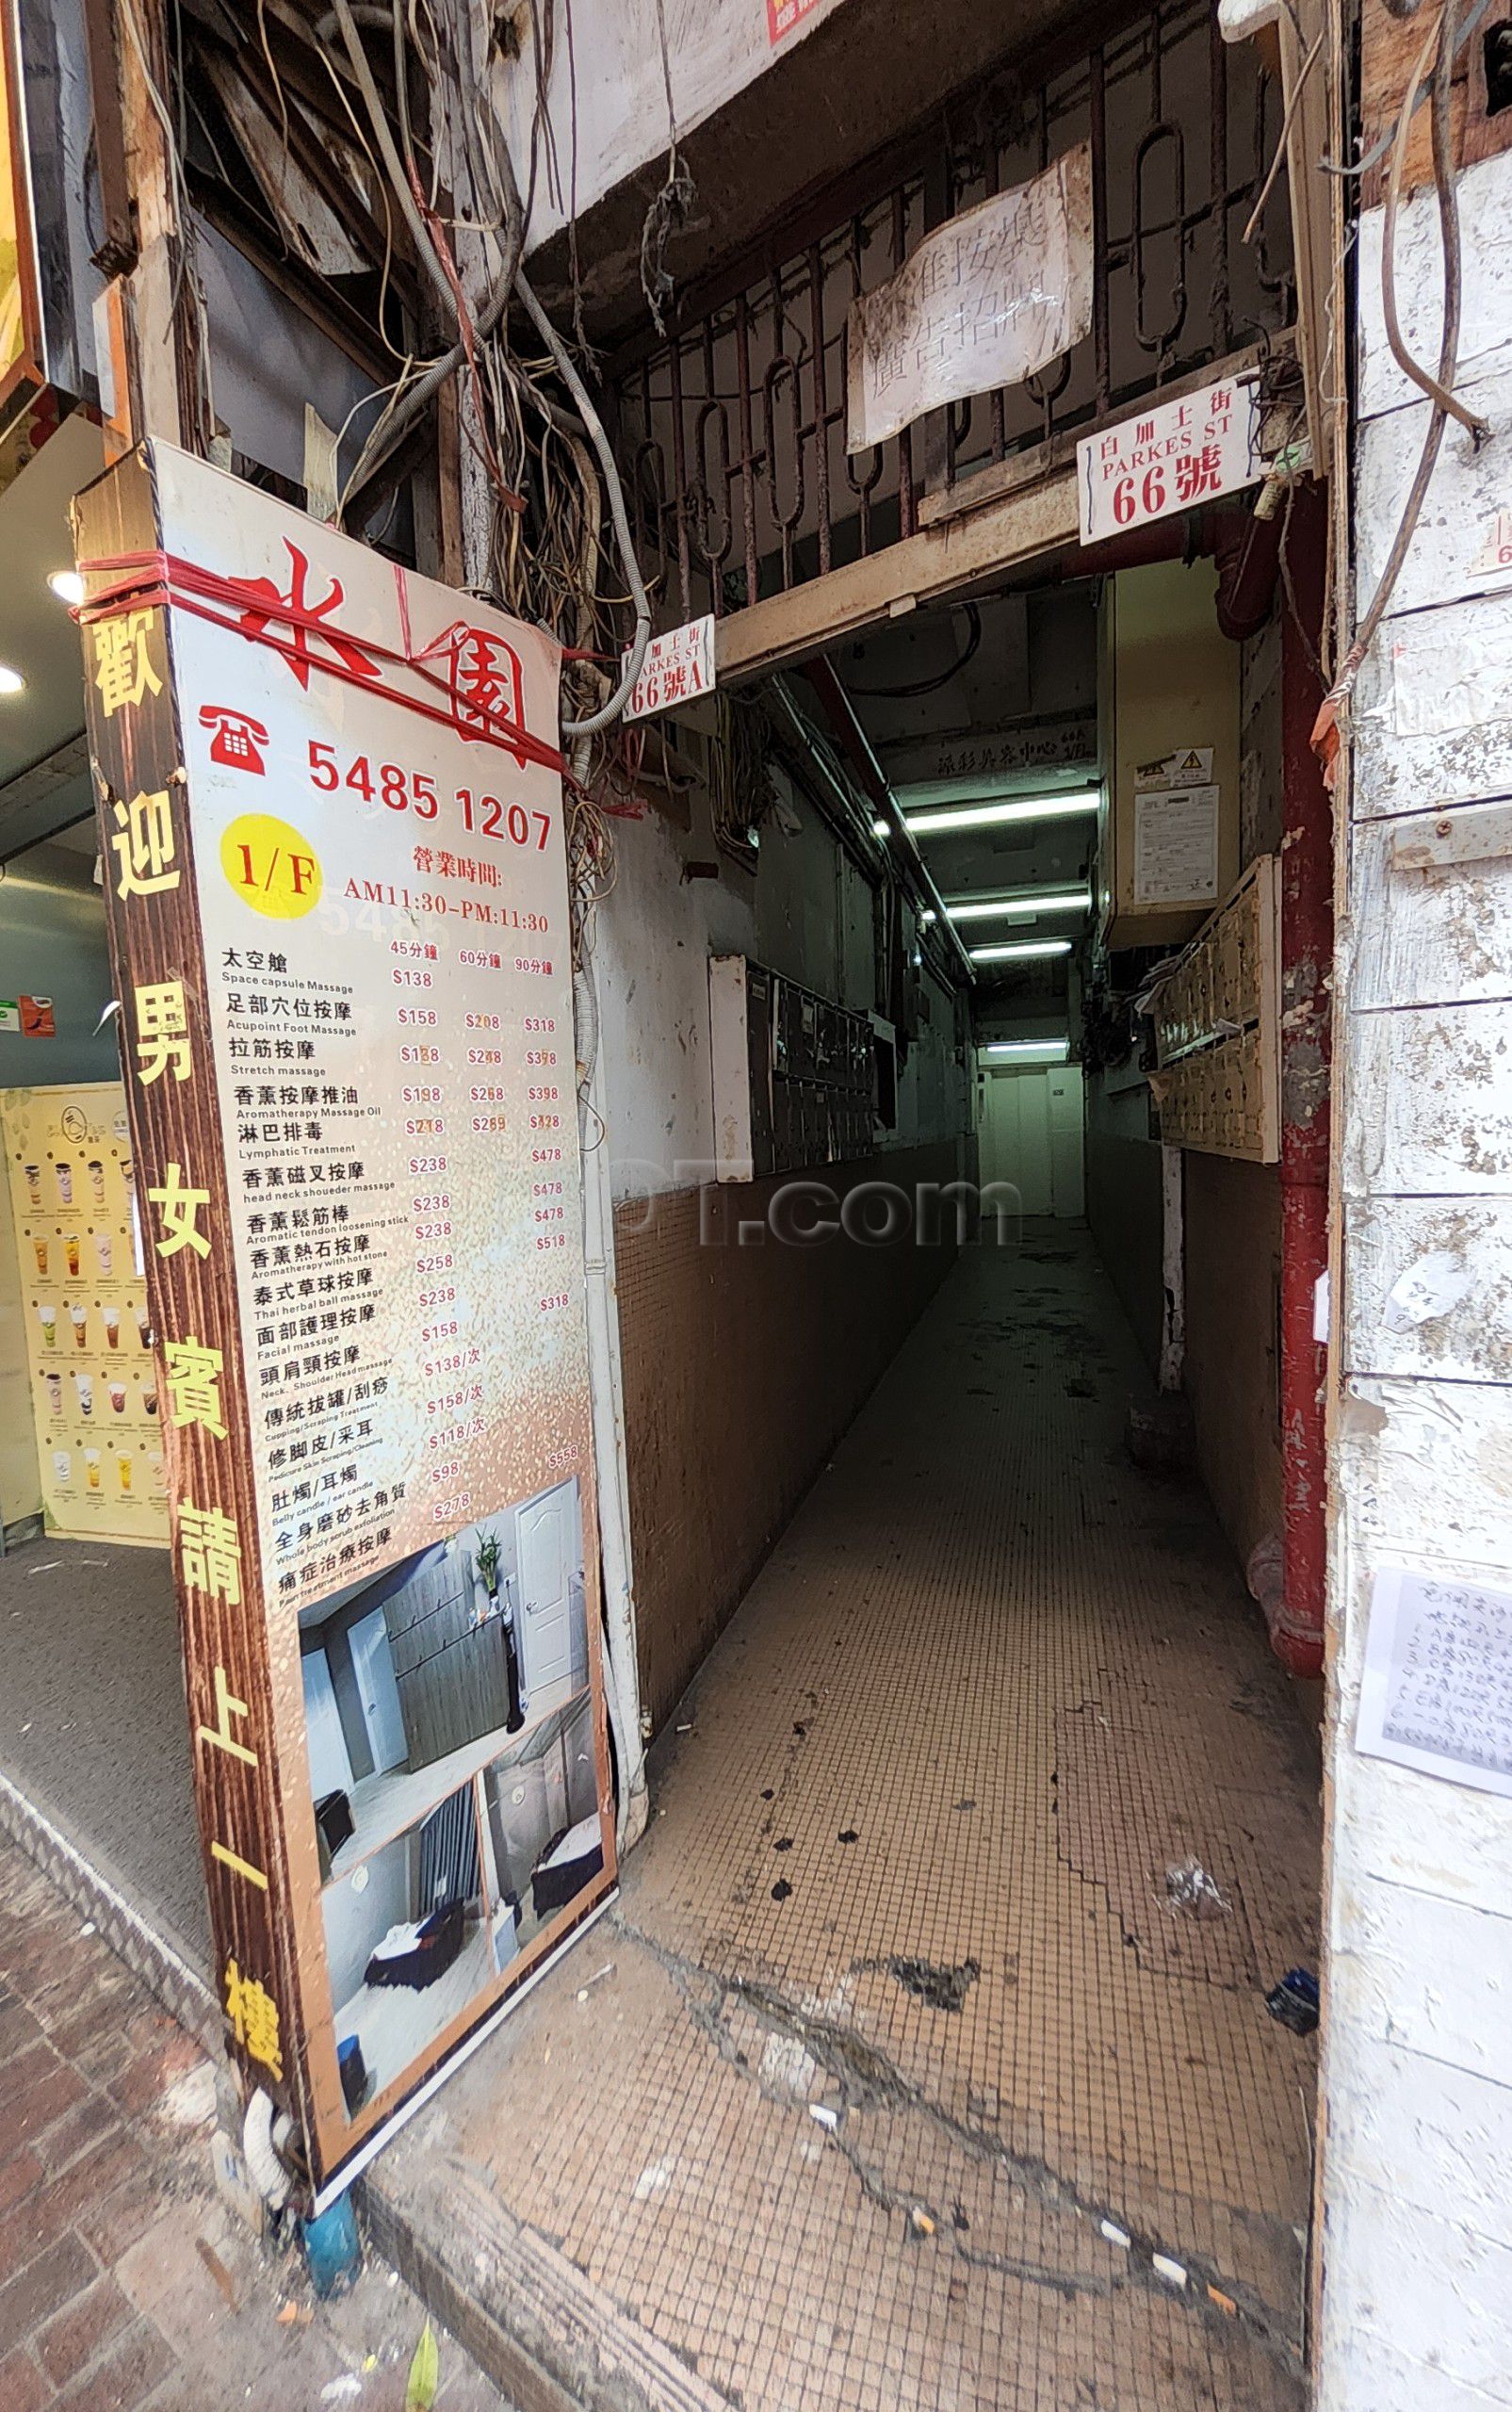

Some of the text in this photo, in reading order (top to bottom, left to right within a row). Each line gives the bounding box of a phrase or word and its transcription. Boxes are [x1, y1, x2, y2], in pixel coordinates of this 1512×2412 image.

[1100, 387, 1232, 461] 白加士街
[1102, 414, 1233, 481] PARKES ST
[1113, 443, 1223, 525] 66號
[642, 644, 701, 677] ARKES ST
[308, 740, 551, 851] 5485 1207
[238, 843, 315, 895] 1/F
[343, 878, 549, 934] AM11:30-PM:11:30
[221, 947, 287, 973] 太空艙
[390, 940, 438, 961] 45分鐘
[460, 950, 501, 970] 60分鐘
[393, 970, 432, 987] $138
[515, 958, 553, 975] 90分鐘
[221, 971, 353, 995] Space capsule Massage
[226, 992, 352, 1020] 足部穴位按摩
[398, 1009, 437, 1025] $158
[227, 1019, 357, 1036] Acupoint Foot Massage
[525, 1019, 555, 1033] $318
[228, 1036, 316, 1060] 拉筋按摩
[231, 1065, 326, 1078] Stretch massage
[234, 1084, 358, 1105] 香薰按摩推油
[236, 1106, 382, 1119] Aromatherapy Massage Oil
[237, 1121, 323, 1144] 淋巴排毒
[238, 1144, 356, 1161] Lymphatic Treatment
[531, 1149, 561, 1163] $478
[410, 1157, 447, 1173] $238
[243, 1191, 272, 1204] head
[275, 1189, 301, 1200] neck
[353, 1182, 396, 1192] massage
[533, 1182, 562, 1197] $478
[413, 1195, 450, 1212] $238
[534, 1207, 564, 1222] $478
[246, 1214, 409, 1245] Aromatic tendon loosening stick
[415, 1222, 452, 1240] $238
[536, 1234, 565, 1250] $518
[251, 1250, 388, 1280] Aromatherapy with hot stone
[416, 1254, 453, 1273] $258
[252, 1267, 374, 1306] 泰式草球按摩
[419, 1287, 455, 1307] $238
[254, 1288, 383, 1321] Thai herbal ball massage
[540, 1294, 569, 1312] $318
[255, 1303, 376, 1347] 面部護理按摩
[422, 1321, 458, 1342] $158
[92, 609, 283, 2080] 歡迎男女賓請上一樓
[257, 1334, 340, 1361] Facial massage
[258, 1345, 361, 1387] 頭肩頸按摩
[425, 1347, 481, 1377] $138/次
[293, 1376, 333, 1391] Shoulder
[334, 1367, 357, 1379] Head
[357, 1358, 393, 1372] massage
[340, 1401, 378, 1419] Treatment
[427, 1384, 483, 1414] $158/次
[429, 1417, 485, 1449] $118/次
[548, 1445, 578, 1468] $558
[431, 1461, 460, 1483] $98
[272, 1513, 295, 1527] Belly
[296, 1499, 325, 1516] candle
[332, 1492, 345, 1503] ear
[347, 1480, 374, 1495] candle
[433, 1493, 470, 1520] $278
[274, 1481, 407, 1553] 全身磨砂去角質
[275, 1508, 396, 1565] Whole body scrub exfoliation
[279, 1526, 393, 1594] 痛症治療按摩
